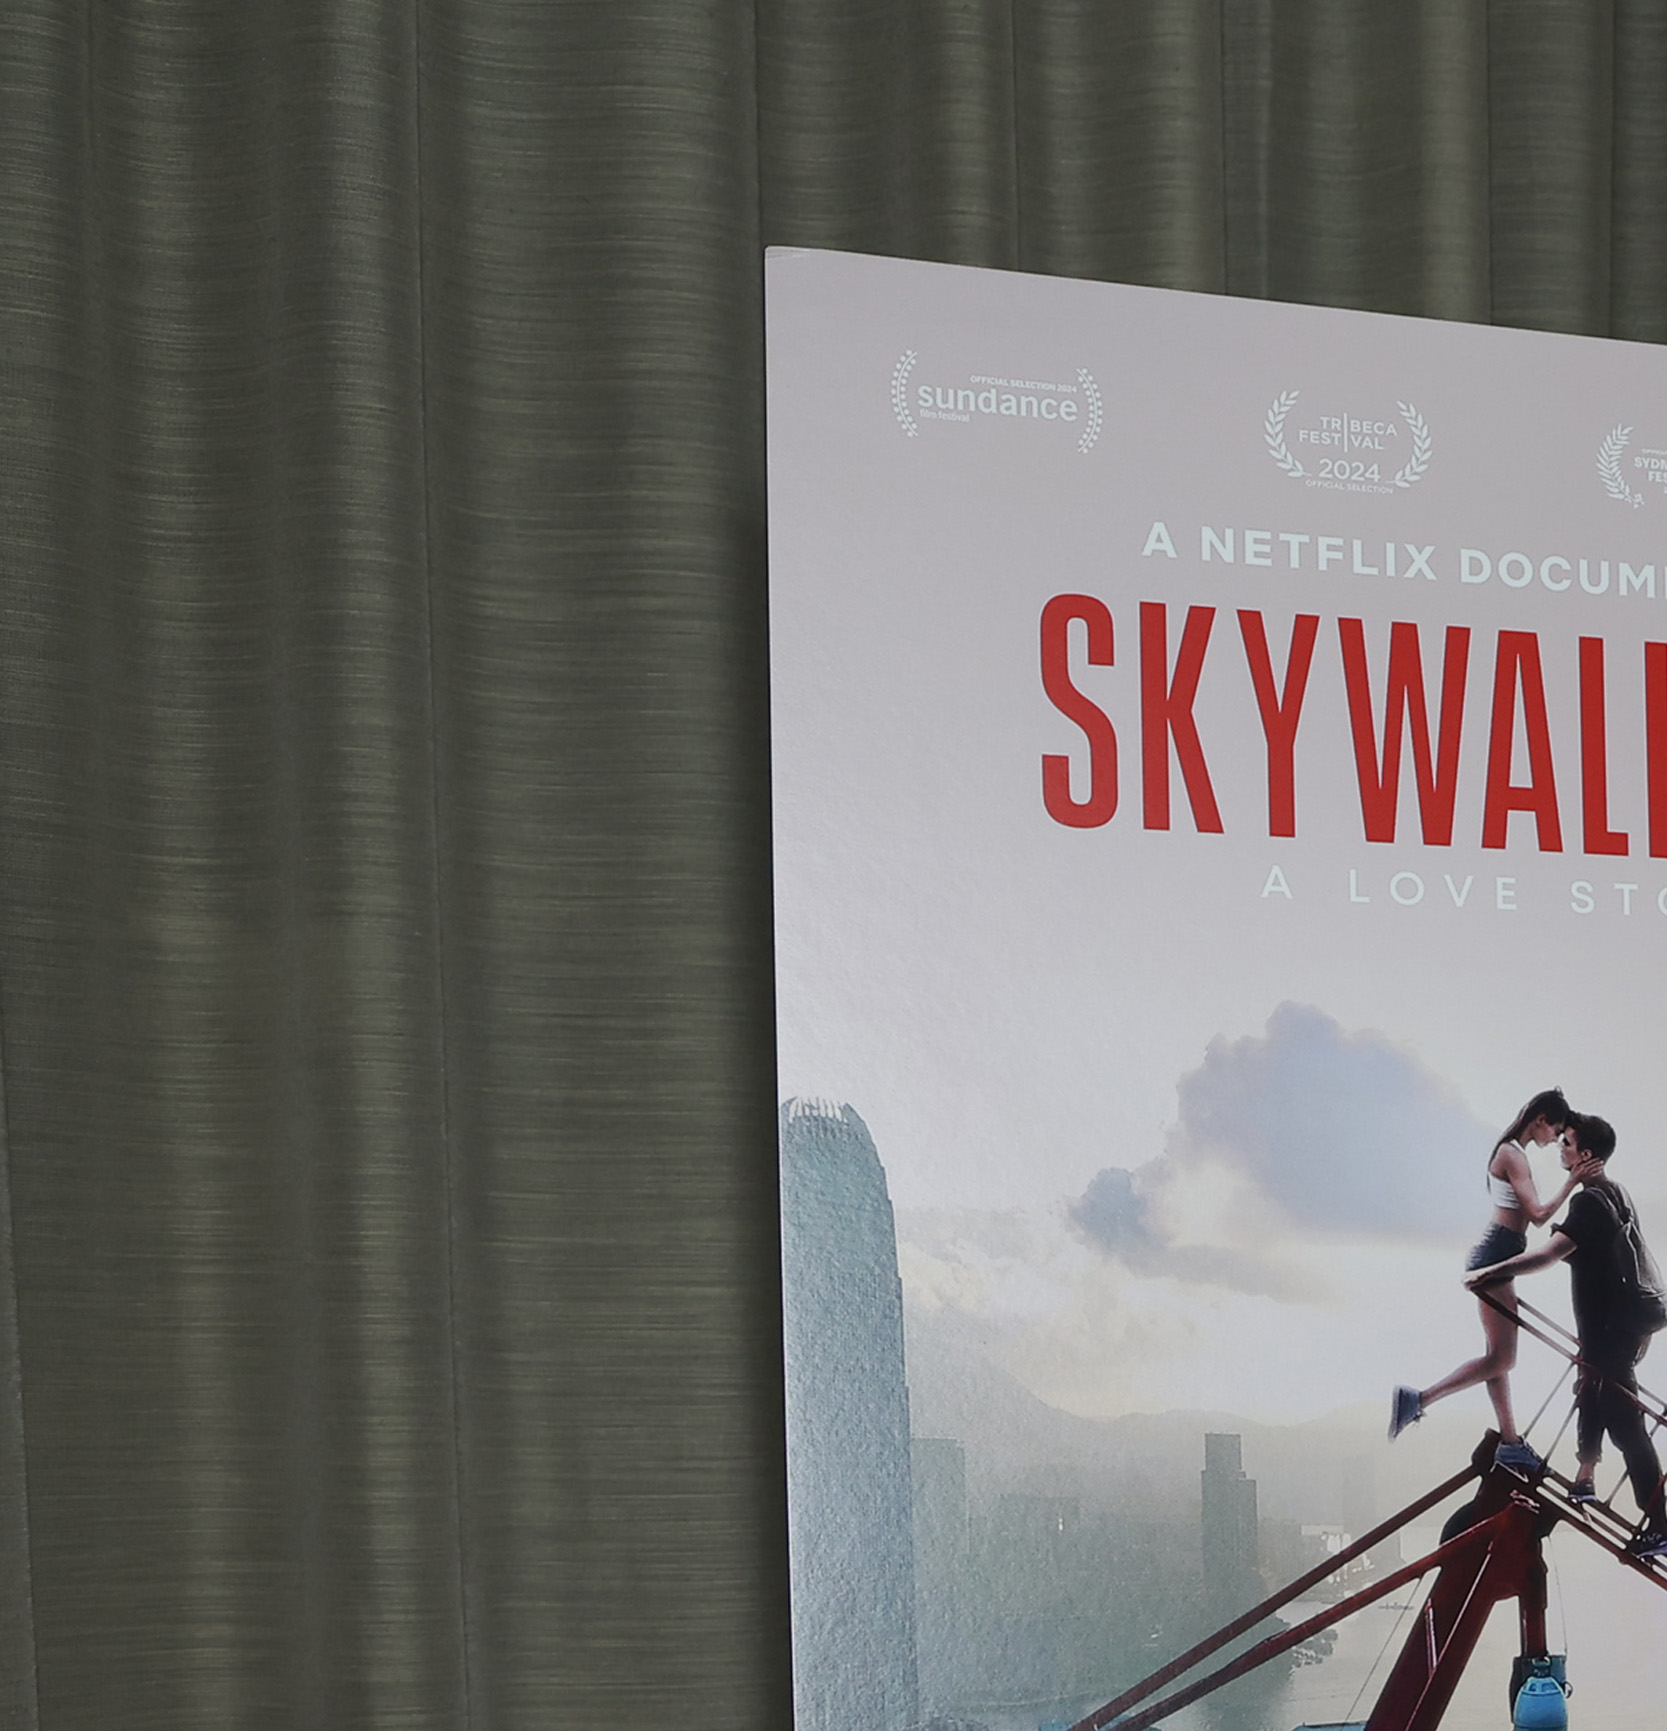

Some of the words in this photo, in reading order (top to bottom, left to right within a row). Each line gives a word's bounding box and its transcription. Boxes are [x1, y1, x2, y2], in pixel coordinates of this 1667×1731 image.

[970, 375, 1008, 387] OFFICIAL
[1010, 379, 1056, 392] SELECTION
[1057, 383, 1077, 393] 2024
[917, 385, 1078, 421] sundance
[919, 408, 937, 419] film
[938, 410, 970, 422] festival
[1319, 459, 1380, 482] 2024
[1305, 479, 1344, 490] OFFICIAL
[1346, 482, 1394, 494] SELECTION
[1142, 521, 1178, 558] A
[1199, 524, 1437, 581] NETFLIX
[1262, 865, 1293, 898] A
[1348, 870, 1518, 911] LOVE
